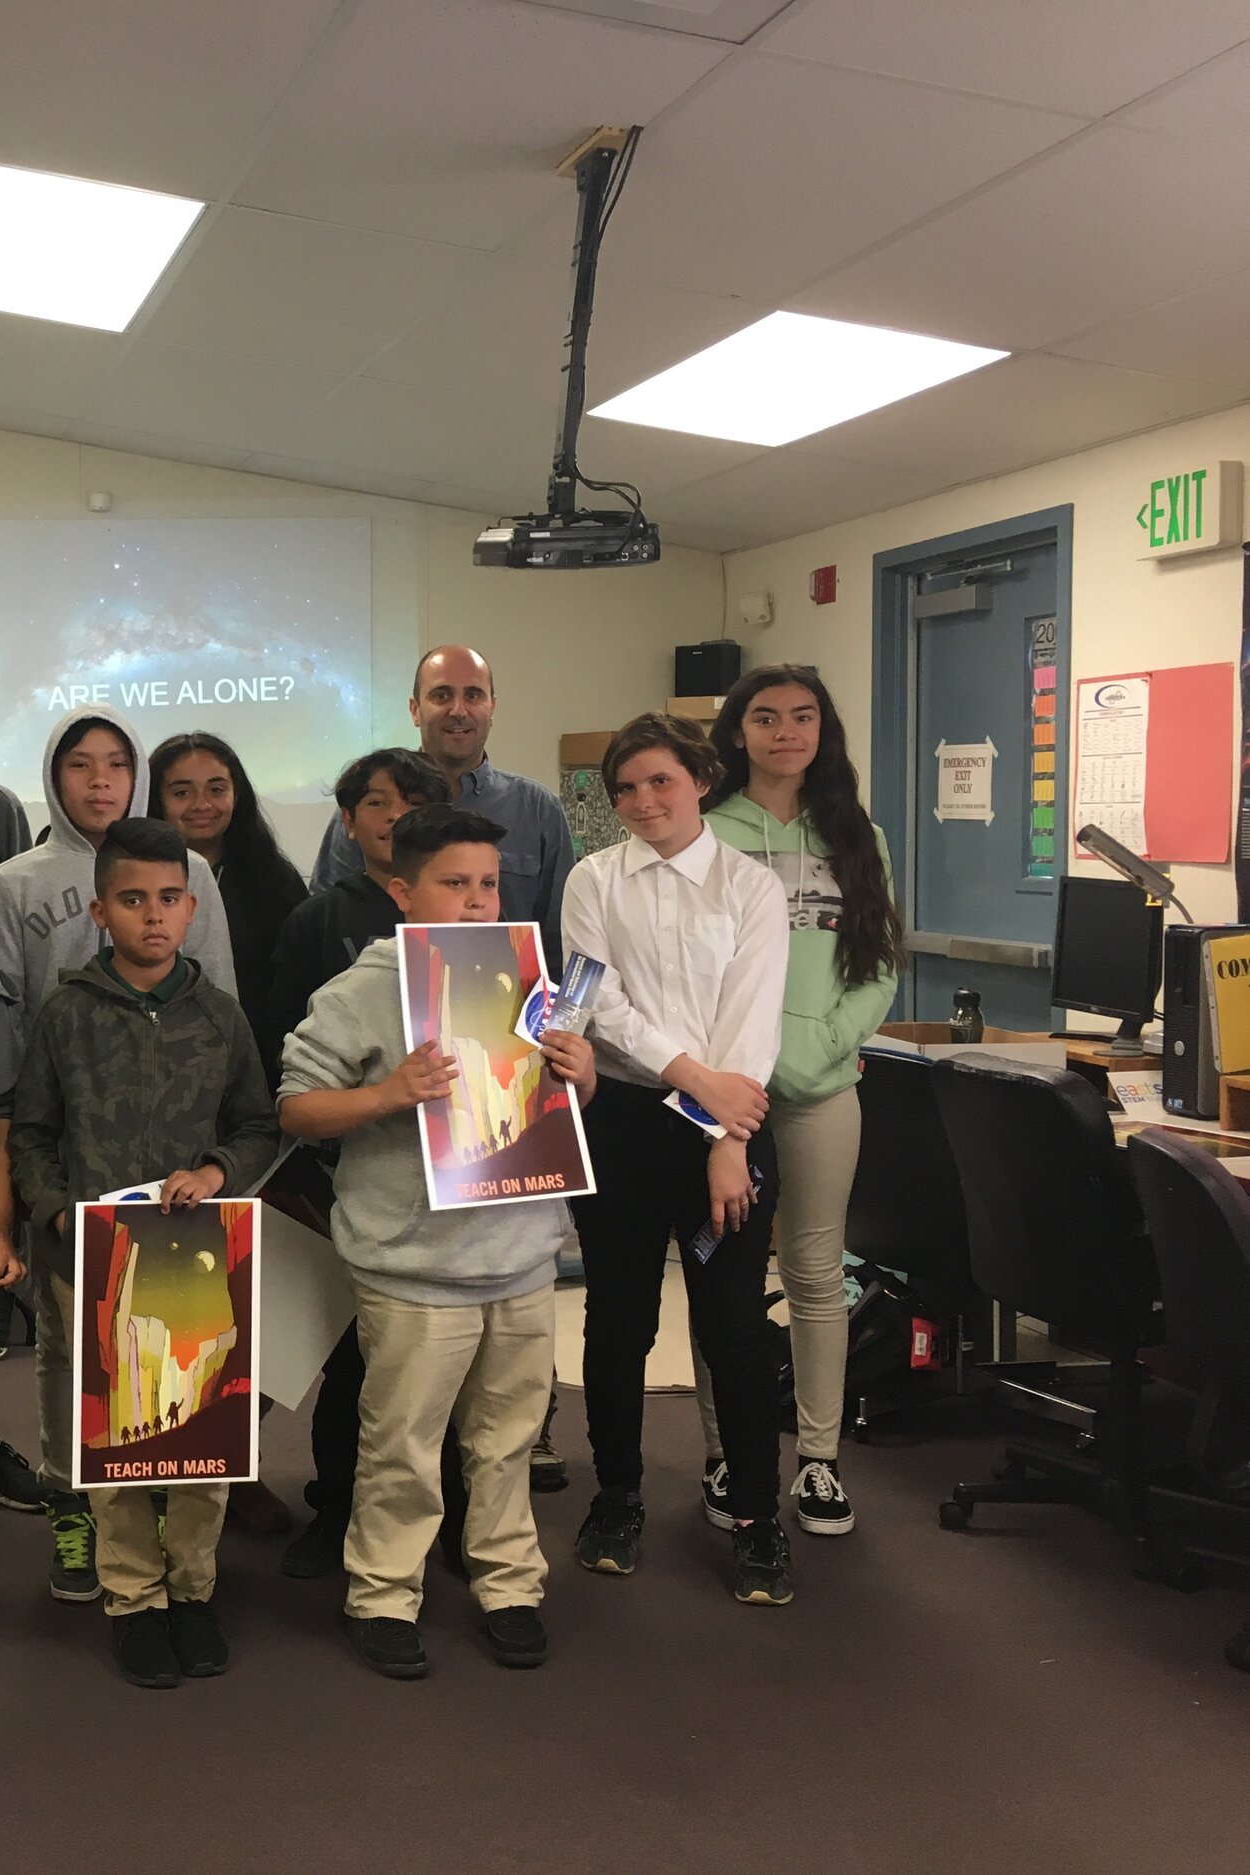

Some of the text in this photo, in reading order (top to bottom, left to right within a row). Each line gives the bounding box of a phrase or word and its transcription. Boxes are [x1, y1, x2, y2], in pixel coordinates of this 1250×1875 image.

[1150, 469, 1207, 548] EXIT
[1036, 622, 1055, 643] 20
[48, 676, 295, 711] ARE WE ALONE?
[944, 757, 987, 768] EMERGENCY
[955, 770, 971, 781] EXIT
[953, 783, 973, 794] ONLY
[24, 886, 83, 940] OLD
[455, 1173, 566, 1199] TEACH ON MARS
[104, 1458, 227, 1479] TEACH ON MARS
